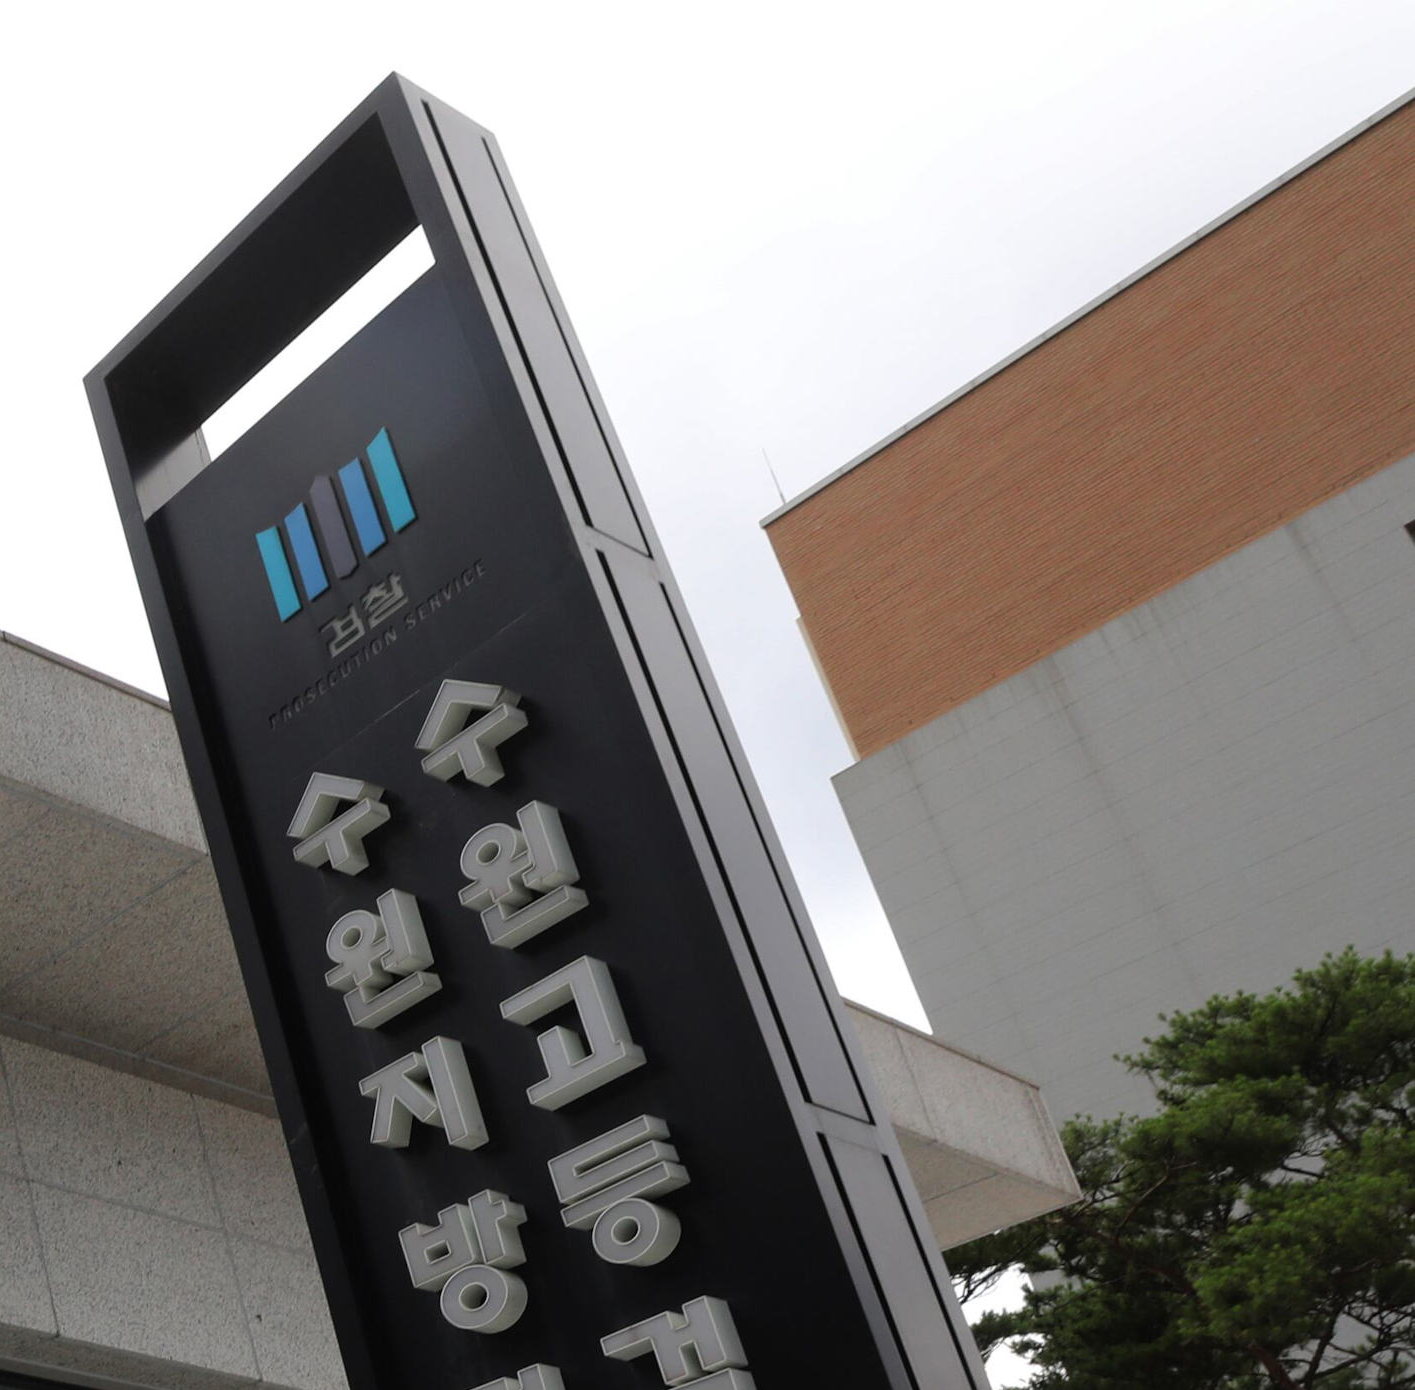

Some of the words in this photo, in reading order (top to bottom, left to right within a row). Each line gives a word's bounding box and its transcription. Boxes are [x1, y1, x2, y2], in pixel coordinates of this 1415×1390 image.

[268, 627, 398, 730] PROSECUTION
[404, 558, 487, 631] SERVICE
[319, 569, 409, 659] 검찰
